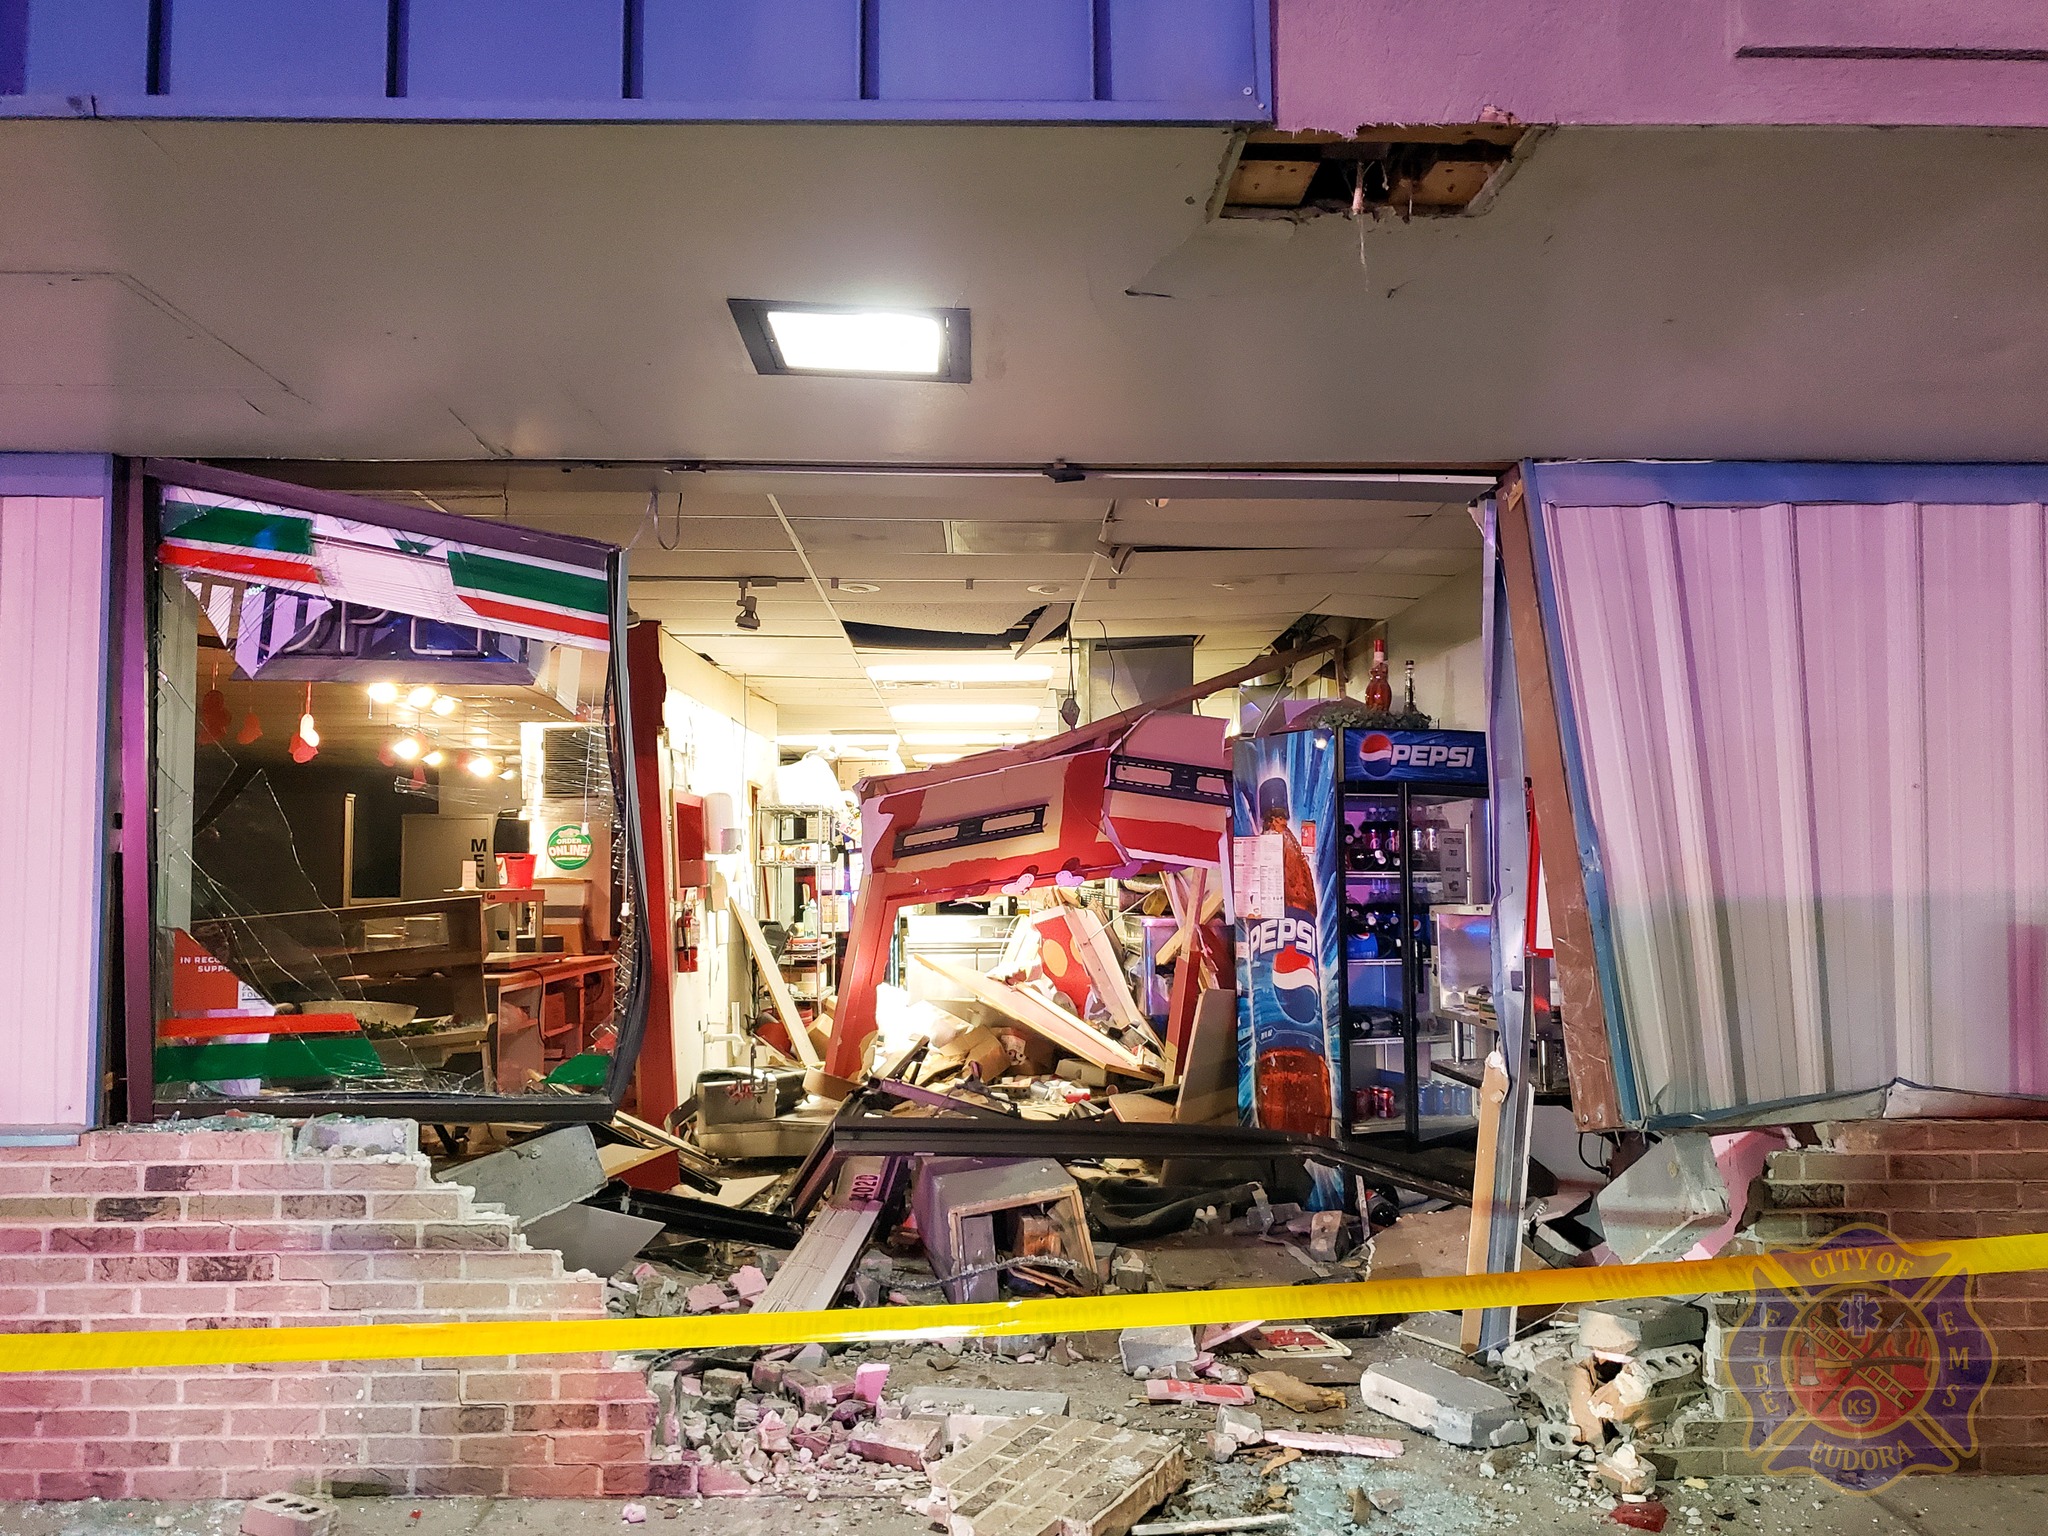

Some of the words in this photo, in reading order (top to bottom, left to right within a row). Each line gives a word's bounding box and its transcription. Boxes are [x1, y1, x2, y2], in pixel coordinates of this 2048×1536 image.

[1390, 744, 1475, 768] PEPSI
[470, 838, 487, 883] MEN
[549, 844, 592, 857] ONLINE!
[1250, 917, 1316, 960] PEPSI
[180, 956, 192, 964] IN
